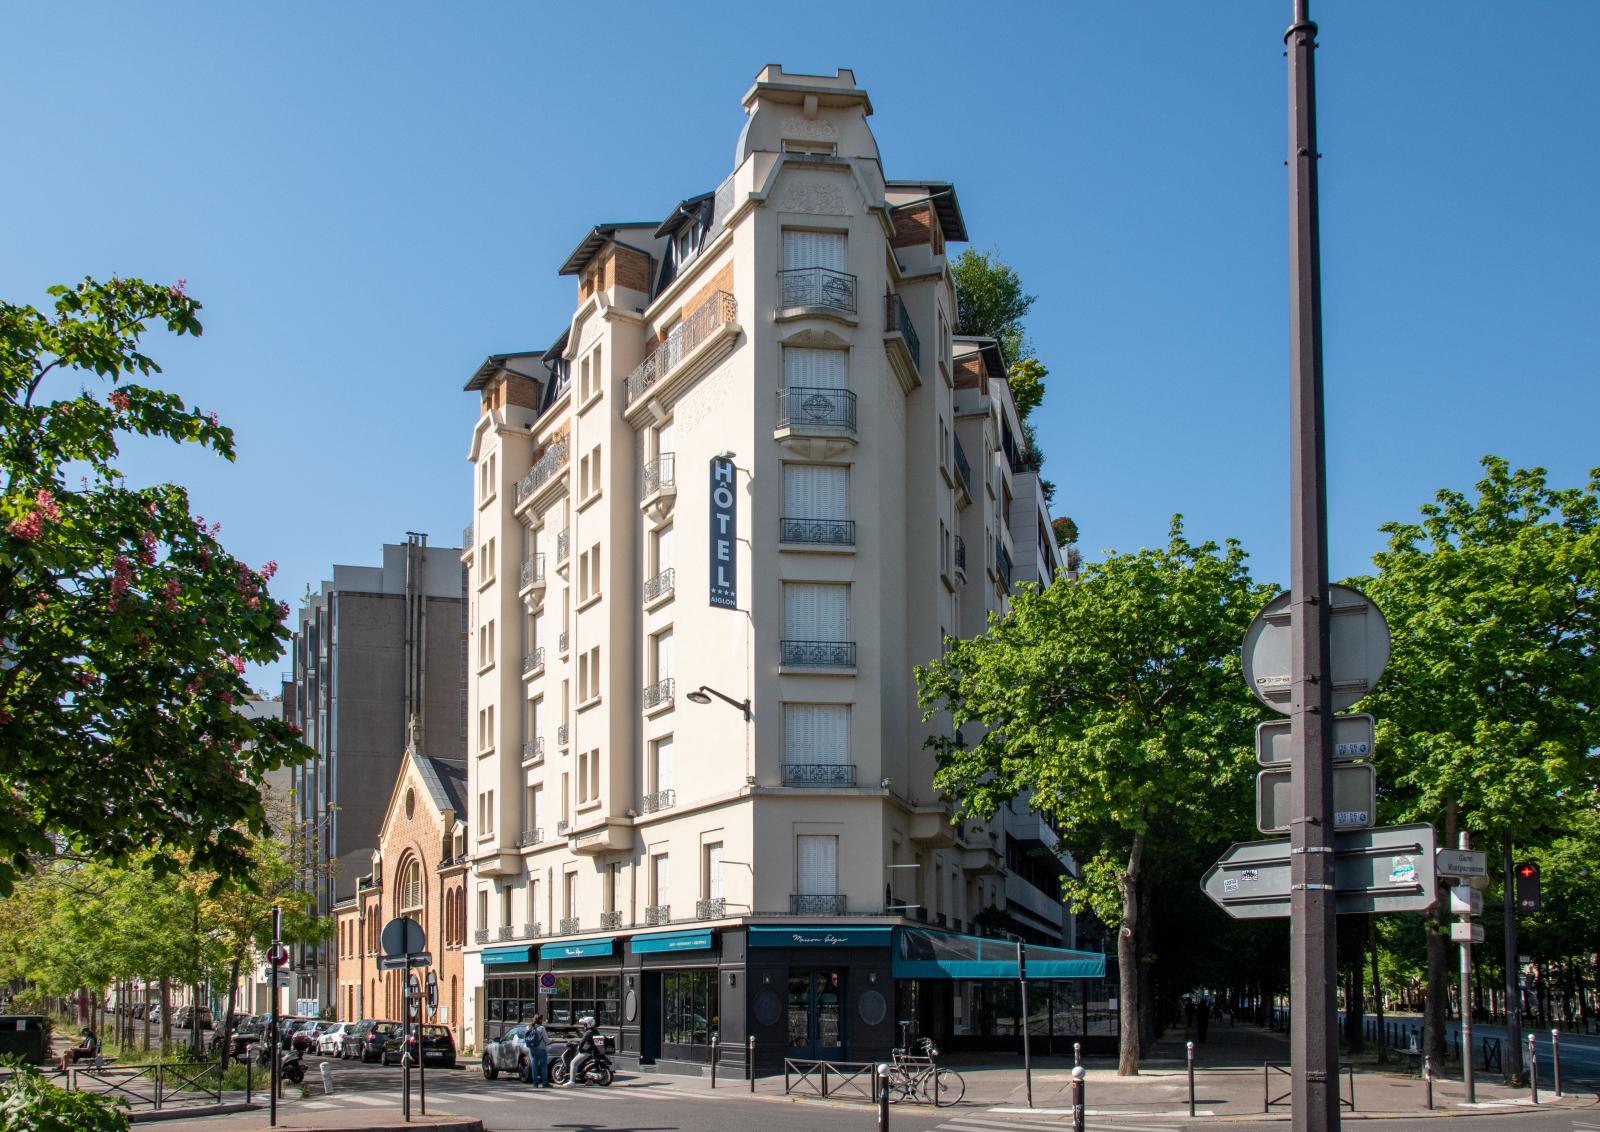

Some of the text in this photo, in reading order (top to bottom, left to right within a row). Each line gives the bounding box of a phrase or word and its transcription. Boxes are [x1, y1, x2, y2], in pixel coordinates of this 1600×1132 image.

[713, 460, 733, 588] HÔTEL
[710, 596, 736, 606] AIGLON
[792, 934, 849, 945] Maison Edgar
